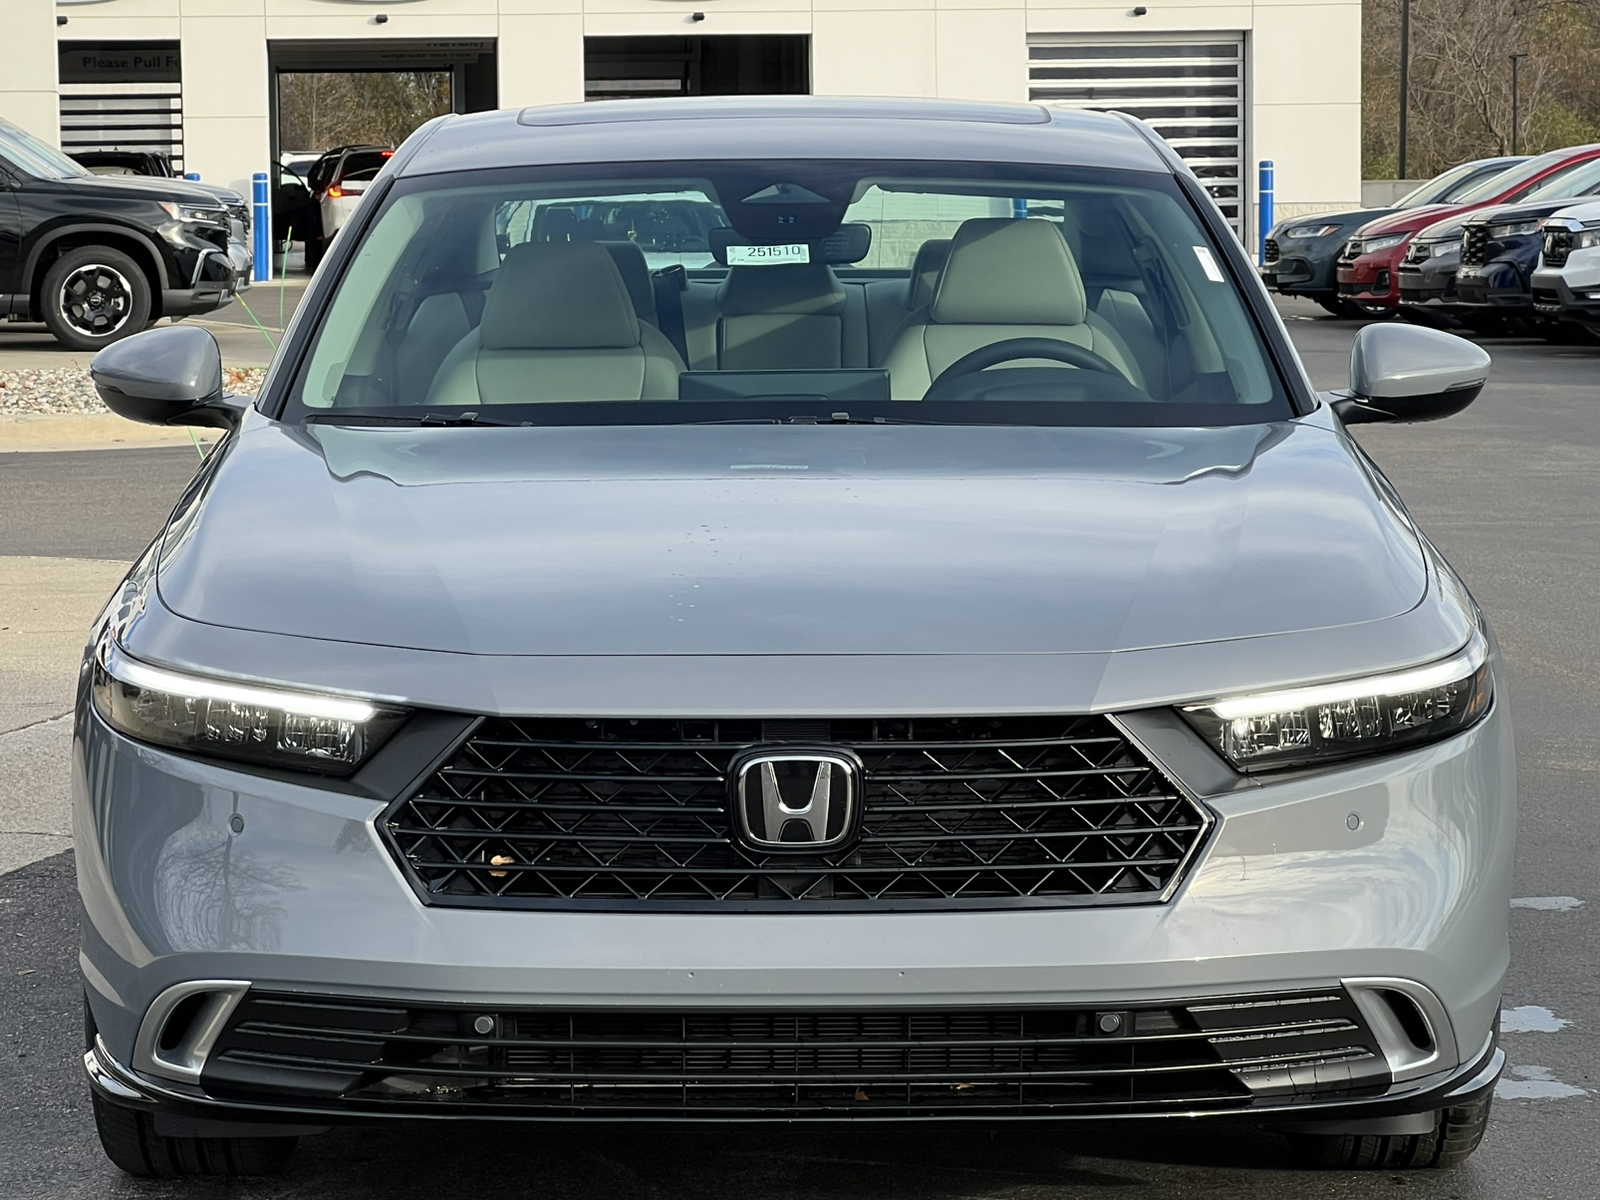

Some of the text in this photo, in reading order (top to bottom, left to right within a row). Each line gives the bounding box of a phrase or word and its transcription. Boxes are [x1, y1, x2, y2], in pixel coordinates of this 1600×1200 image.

[82, 56, 129, 68] Please
[133, 56, 161, 68] Pull
[747, 245, 801, 257] 251510
